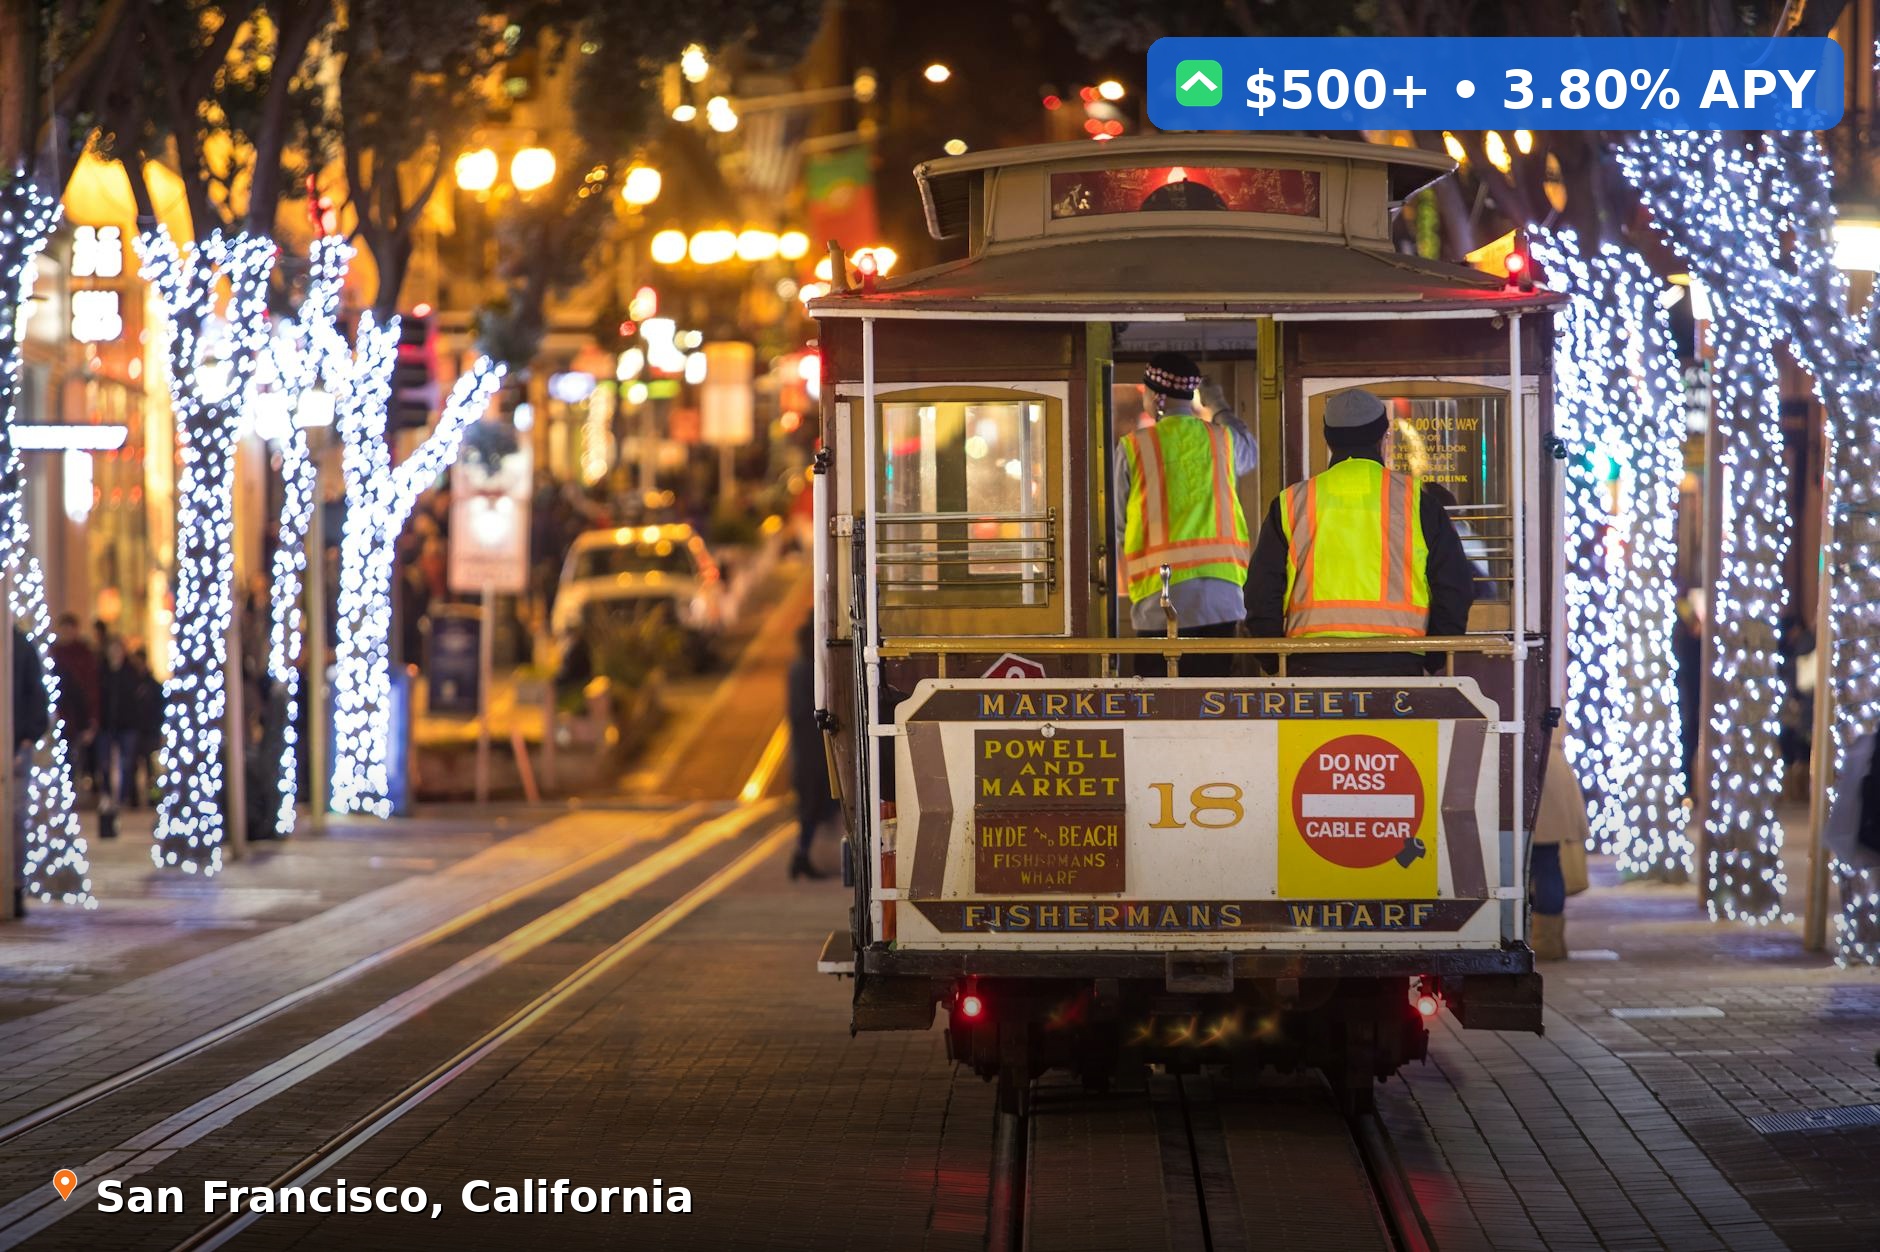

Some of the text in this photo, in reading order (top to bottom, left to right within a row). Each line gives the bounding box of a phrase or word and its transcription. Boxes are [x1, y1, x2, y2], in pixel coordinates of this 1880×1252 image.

[1431, 417, 1454, 431] ONE
[1455, 417, 1479, 431] WAY
[1399, 444, 1436, 452] YELOW
[1437, 444, 1467, 453] FLOOR
[1423, 475, 1468, 483] OR DRINK
[979, 692, 1155, 717] MARKET
[1201, 691, 1373, 717] STREET
[984, 739, 1117, 759] POWELL
[1019, 760, 1085, 775] AND
[1319, 754, 1399, 772] DO NOT
[982, 777, 1120, 797] MARKET
[1332, 773, 1386, 791] PASS
[1148, 782, 1244, 829] 18
[982, 826, 1028, 848] HYDE
[1059, 825, 1118, 848] BEACH
[1306, 821, 1411, 838] CABLE CAR
[1020, 870, 1078, 885] WHARF
[962, 903, 1434, 930] FISHERMANS WHARF
